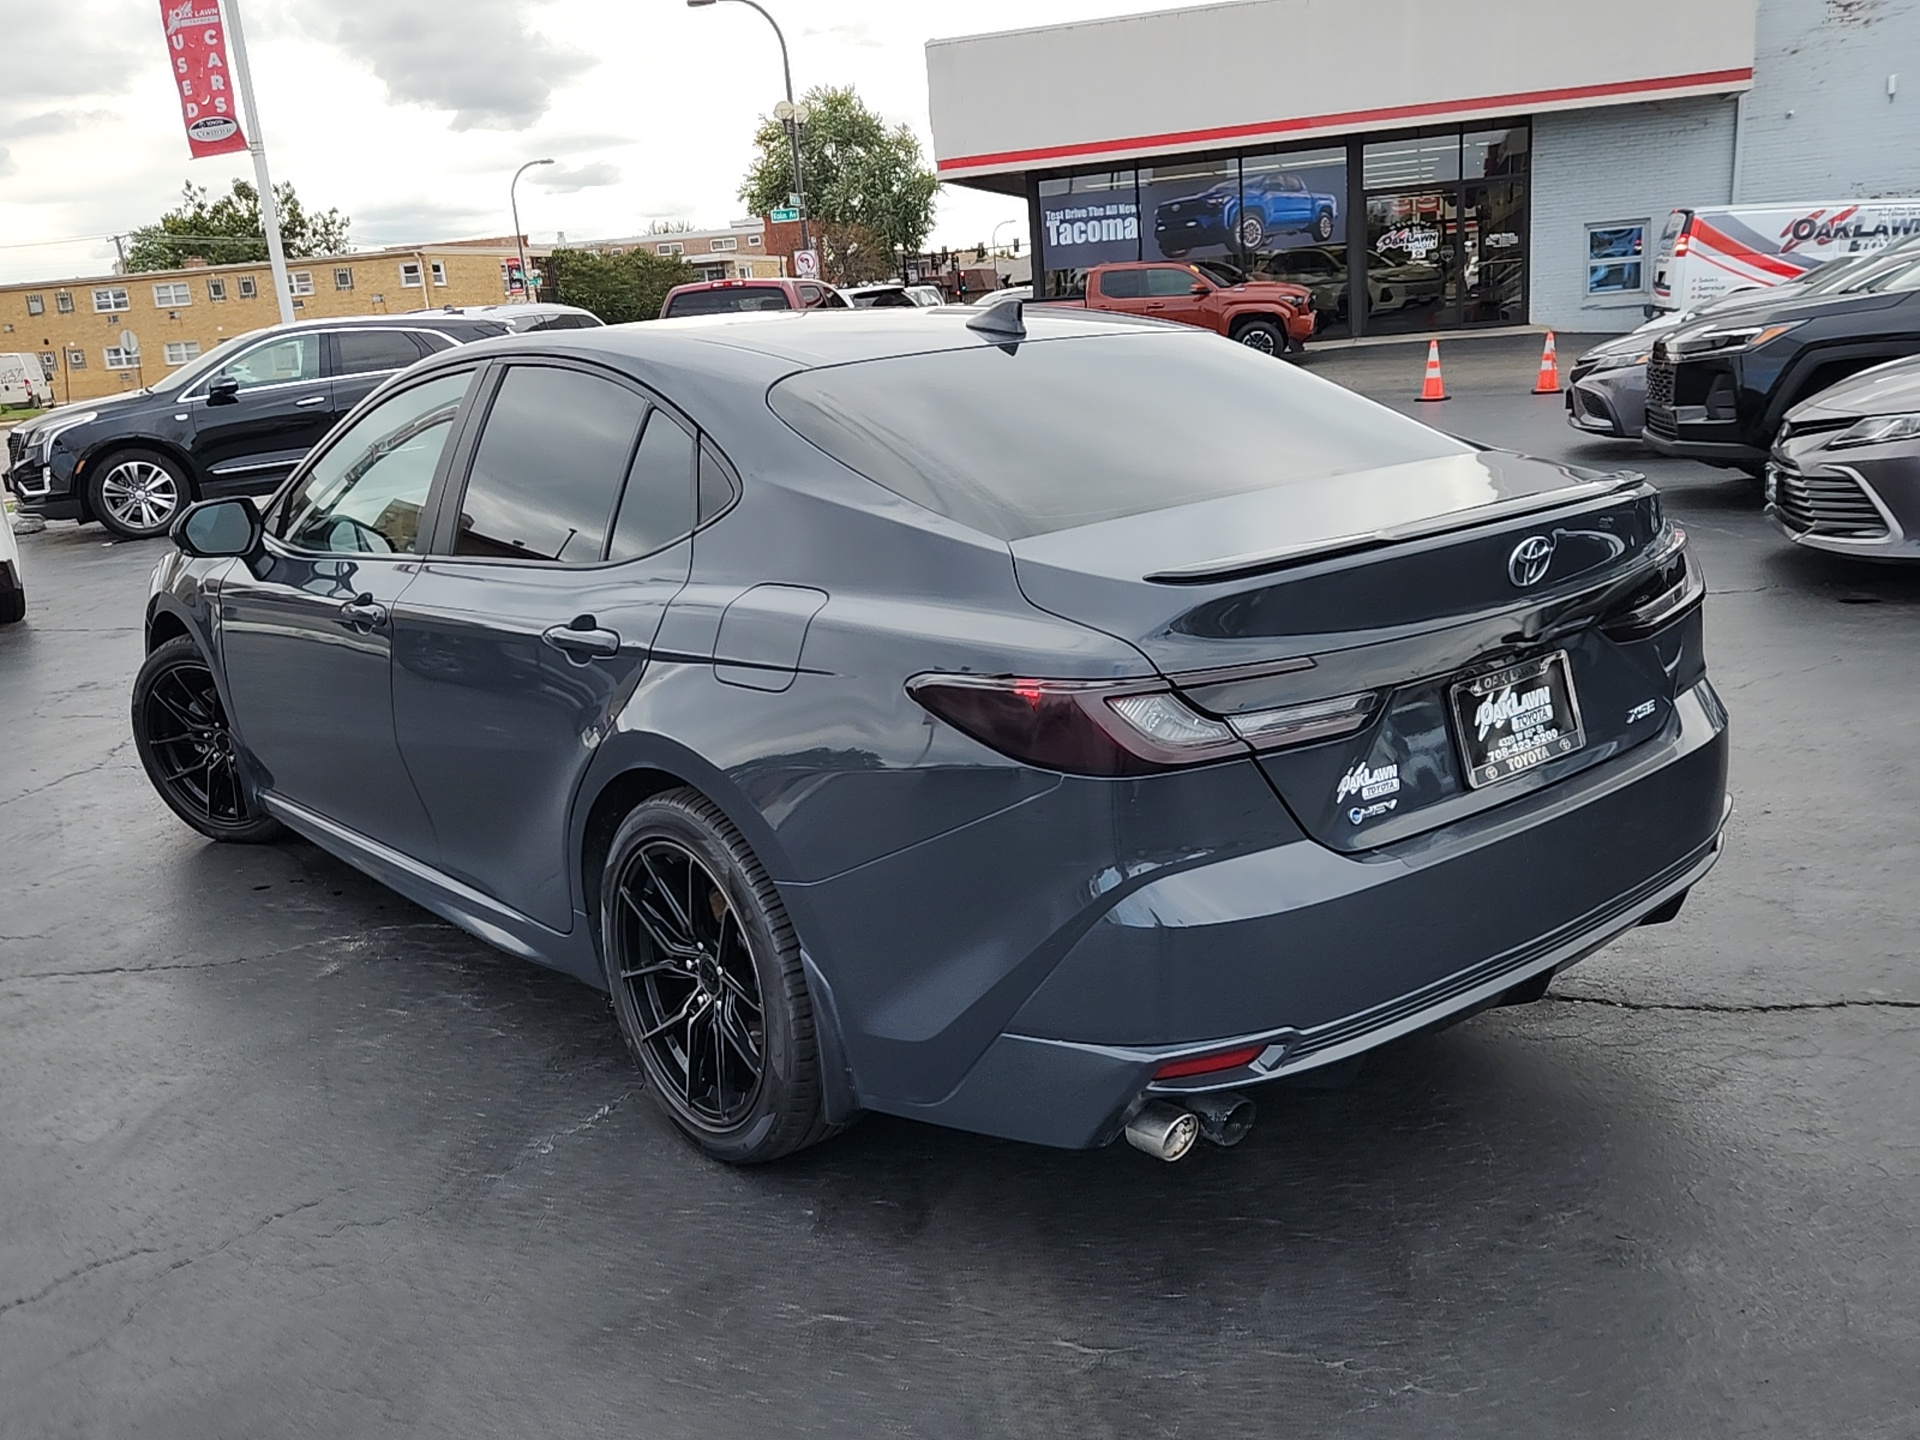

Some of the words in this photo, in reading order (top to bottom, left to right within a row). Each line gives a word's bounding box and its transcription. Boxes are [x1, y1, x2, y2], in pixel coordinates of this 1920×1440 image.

[194, 7, 218, 18] LAWN
[172, 34, 199, 119] USED
[204, 29, 227, 114] CARS
[1045, 210, 1064, 222] Test
[1065, 207, 1088, 219] Drive
[1088, 206, 1105, 217] The
[1106, 204, 1118, 215] All
[1046, 217, 1143, 246] Tacoma
[1790, 216, 1920, 241] OAKLAW
[1517, 707, 1549, 728] TOYOTA
[1626, 699, 1656, 724] XSE
[1487, 728, 1559, 762] 708-423-5200
[1506, 746, 1551, 771] TOYOTA
[1366, 781, 1394, 796] TOYOTA
